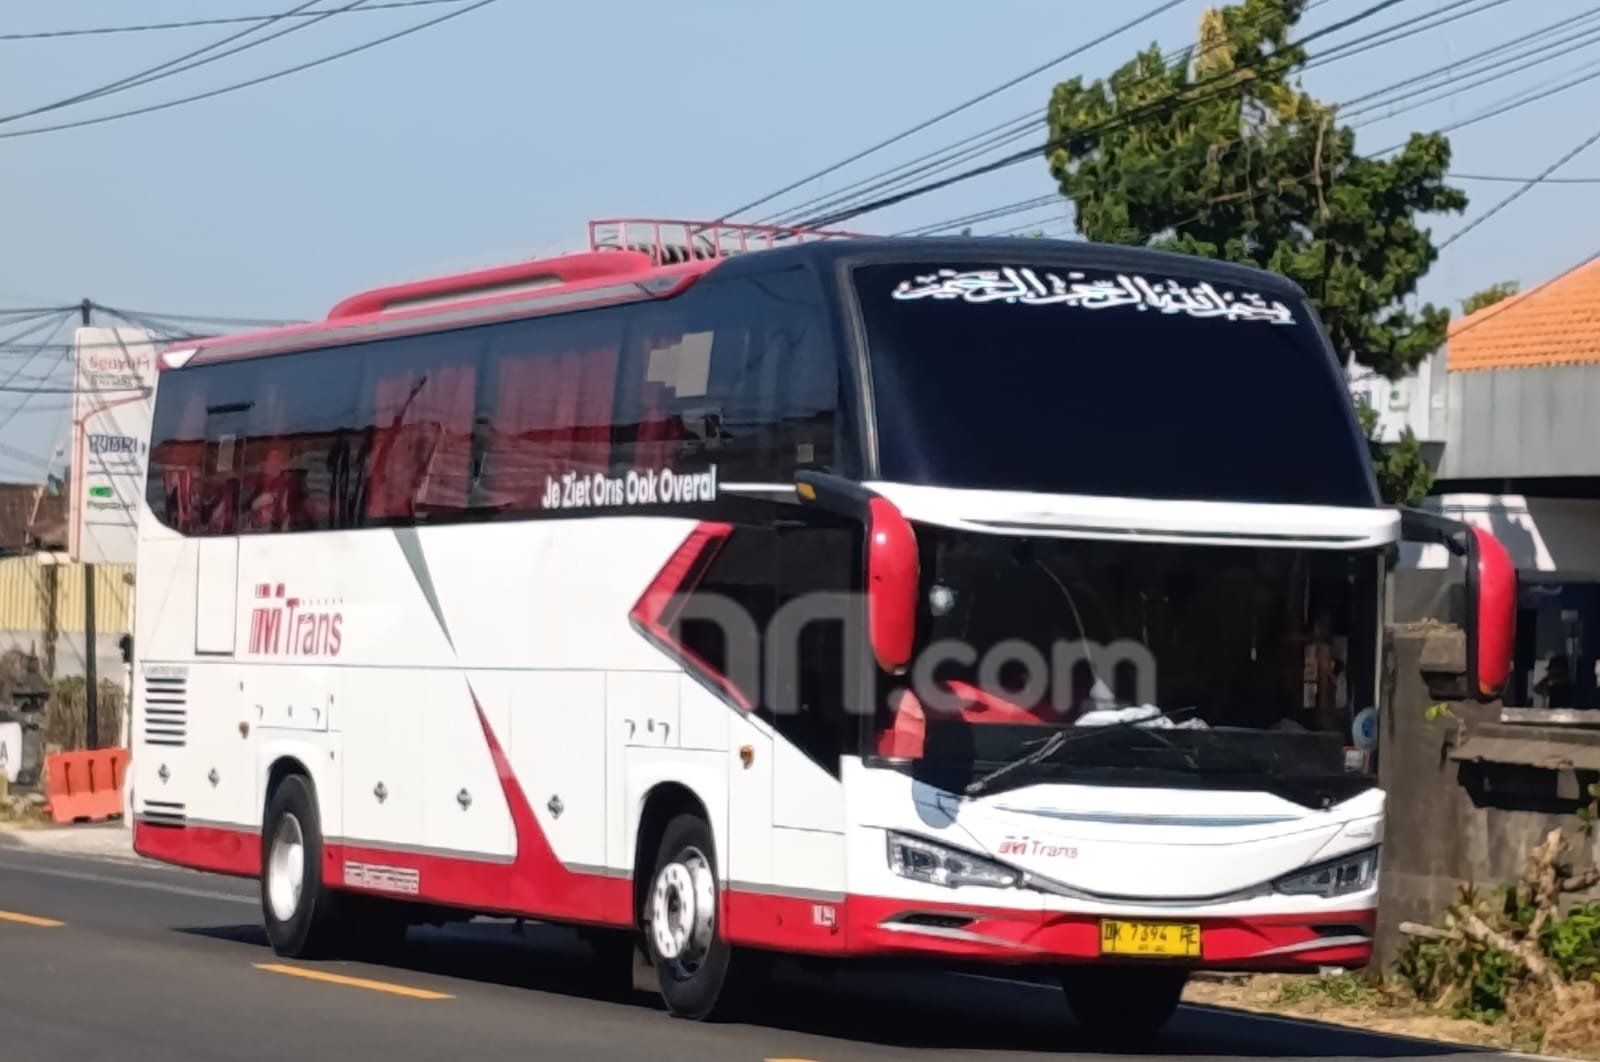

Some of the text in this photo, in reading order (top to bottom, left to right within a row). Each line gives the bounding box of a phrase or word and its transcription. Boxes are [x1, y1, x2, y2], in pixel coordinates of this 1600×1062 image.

[542, 463, 718, 509] Je Ziet Ons Ook Overal
[285, 598, 343, 656] Trans
[1032, 840, 1078, 859] Trans
